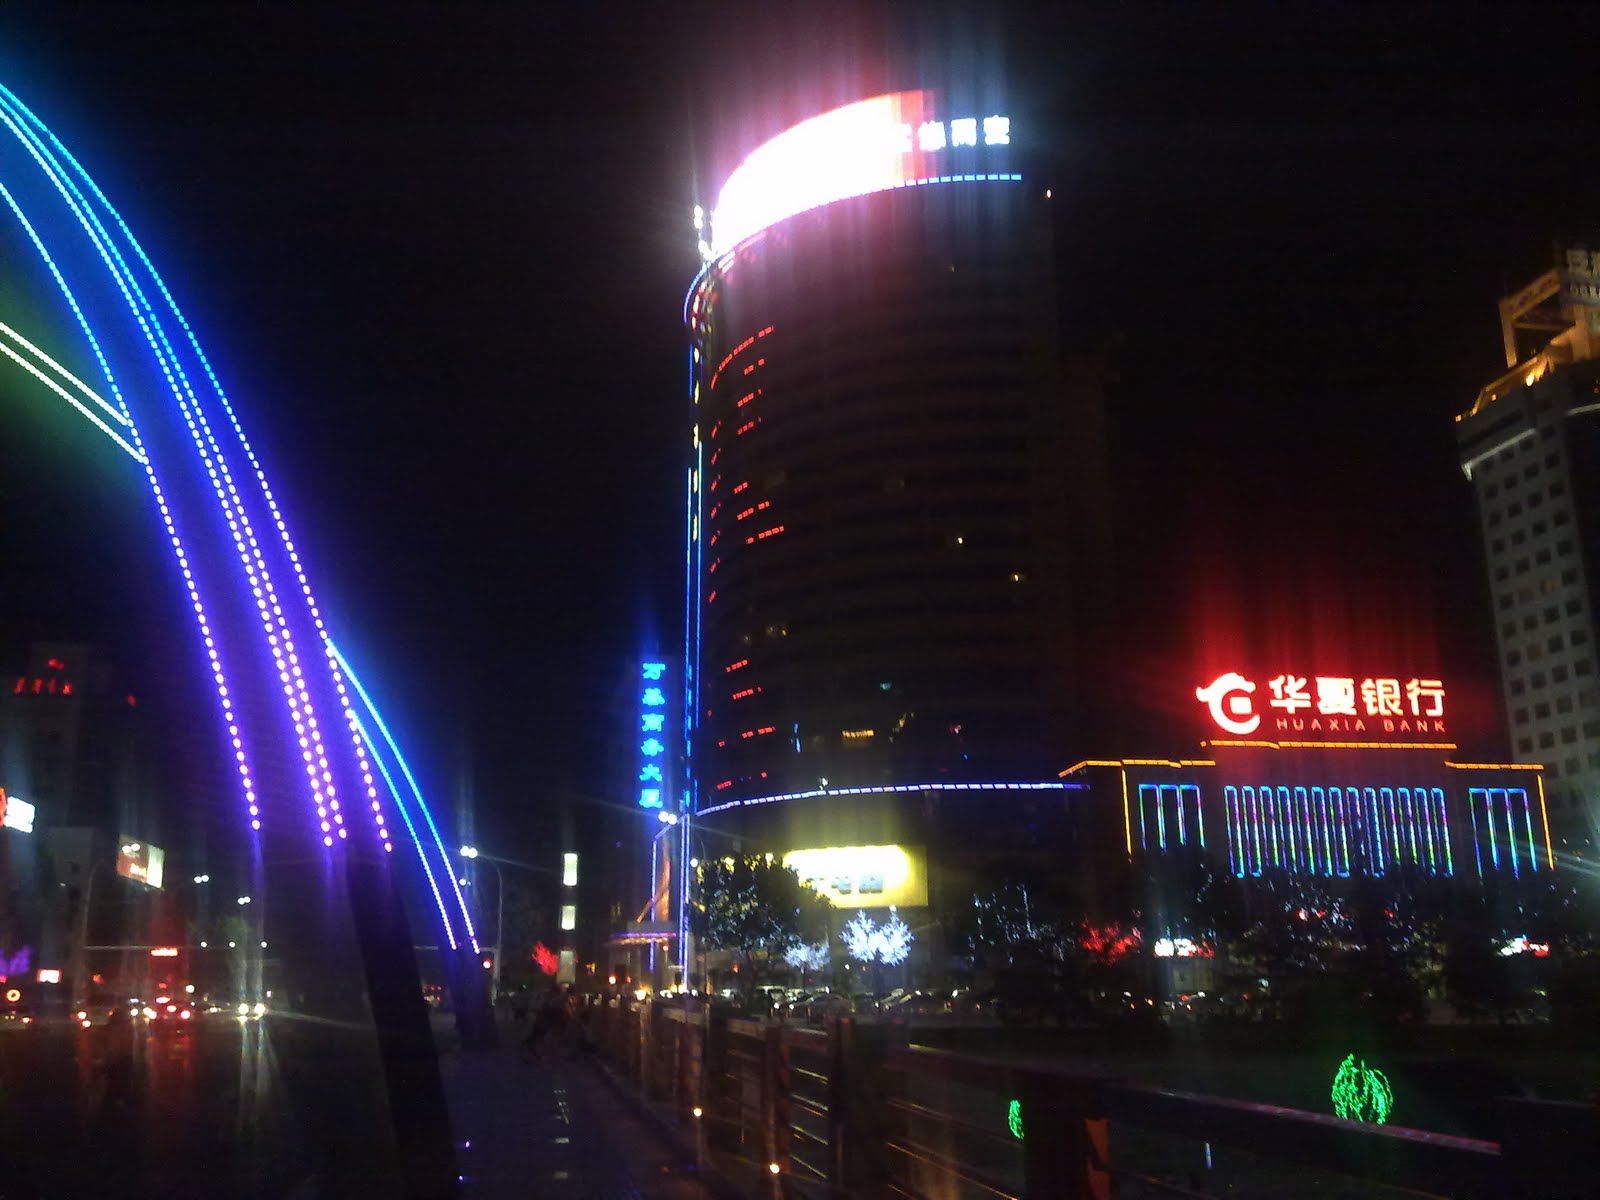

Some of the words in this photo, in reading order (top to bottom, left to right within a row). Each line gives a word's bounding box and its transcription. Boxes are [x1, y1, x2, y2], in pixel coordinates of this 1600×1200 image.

[1268, 675, 1446, 717] 华夏银行
[1276, 717, 1366, 732] HUAXIA
[1384, 718, 1446, 733] BANK
